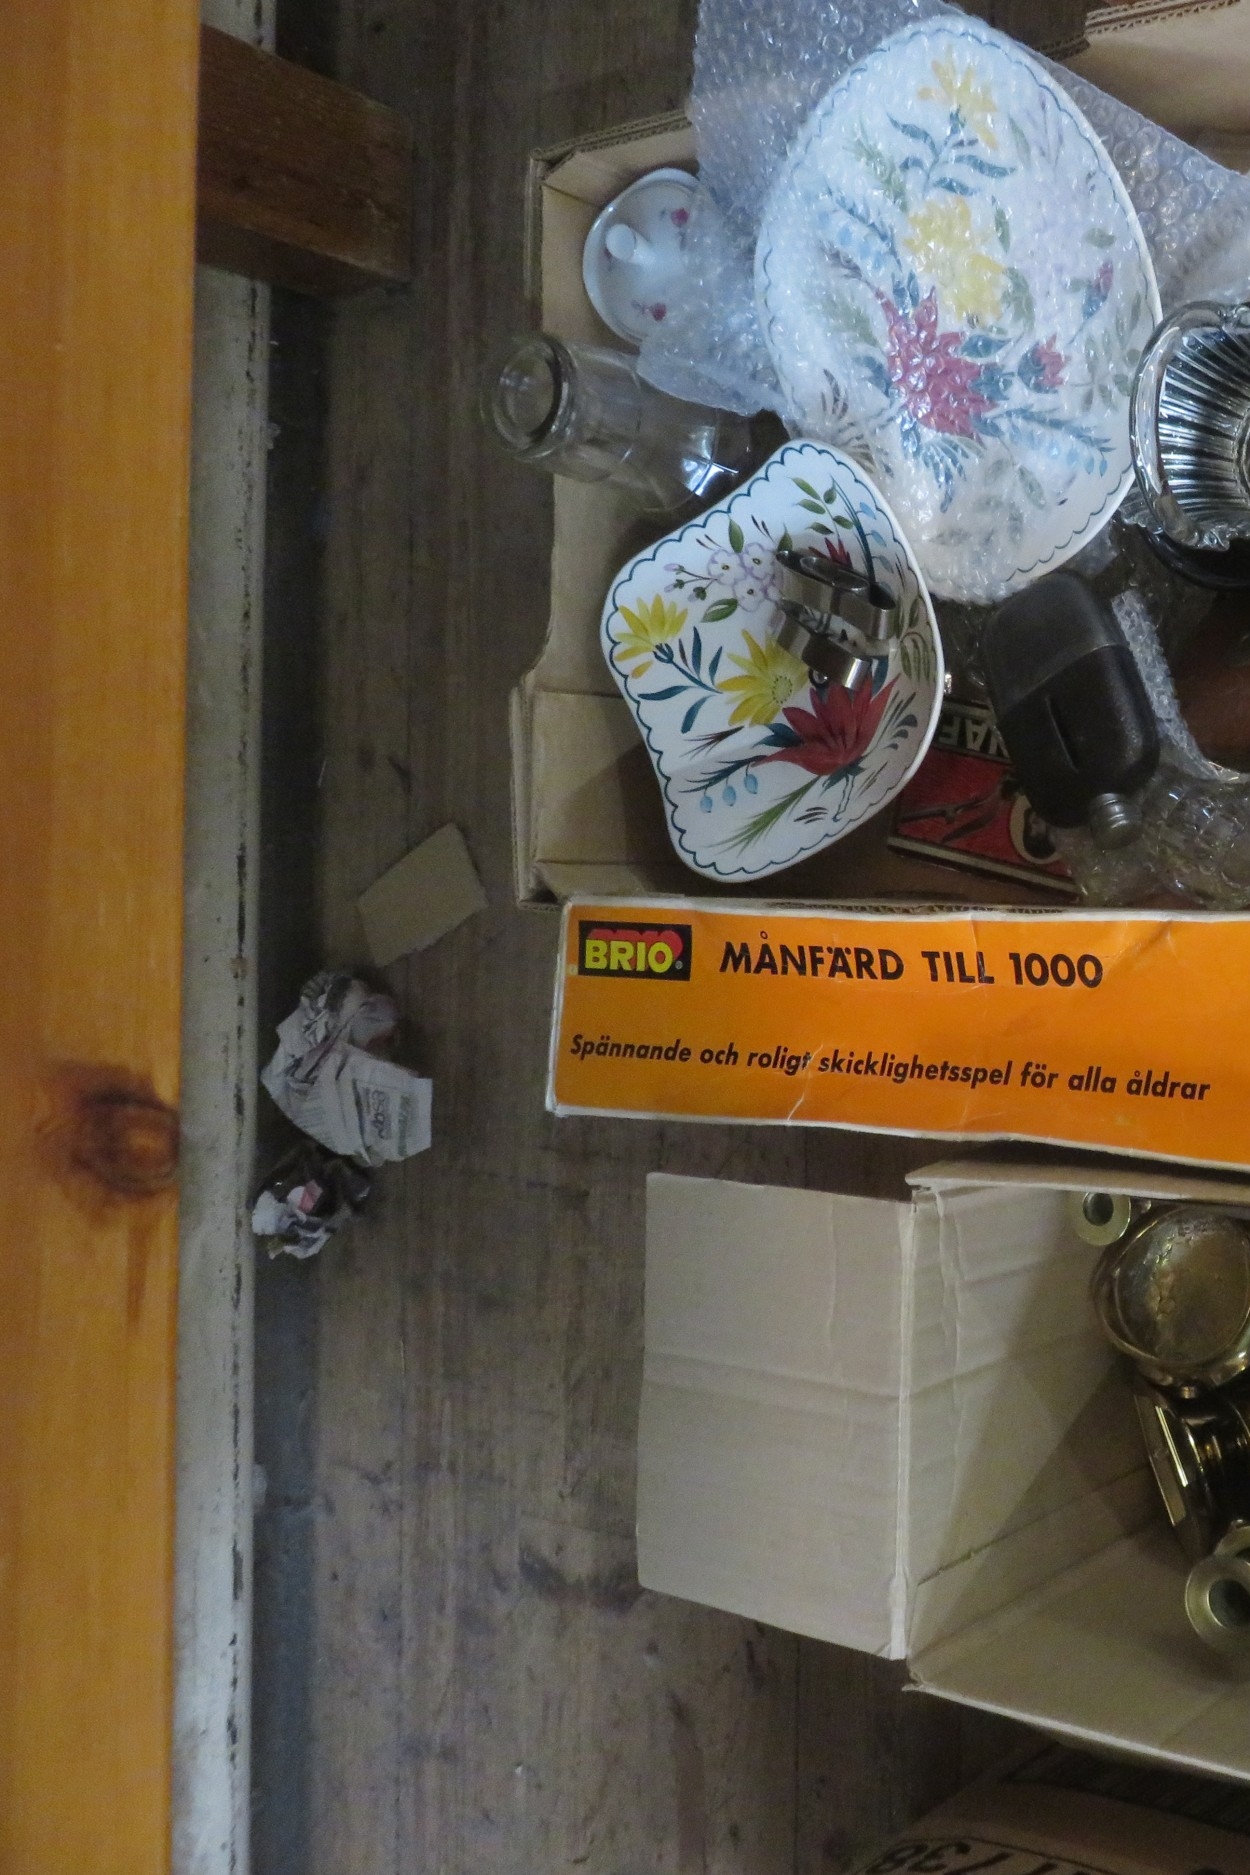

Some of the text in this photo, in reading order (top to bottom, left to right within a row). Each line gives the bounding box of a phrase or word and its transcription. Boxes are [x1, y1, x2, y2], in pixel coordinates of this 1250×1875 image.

[585, 939, 673, 973] BRIO
[719, 930, 1103, 988] MÅNFÄRD TILL 1000
[570, 1033, 1211, 1101] Spännande och roligt skicklighetsspel för alla åldrar
